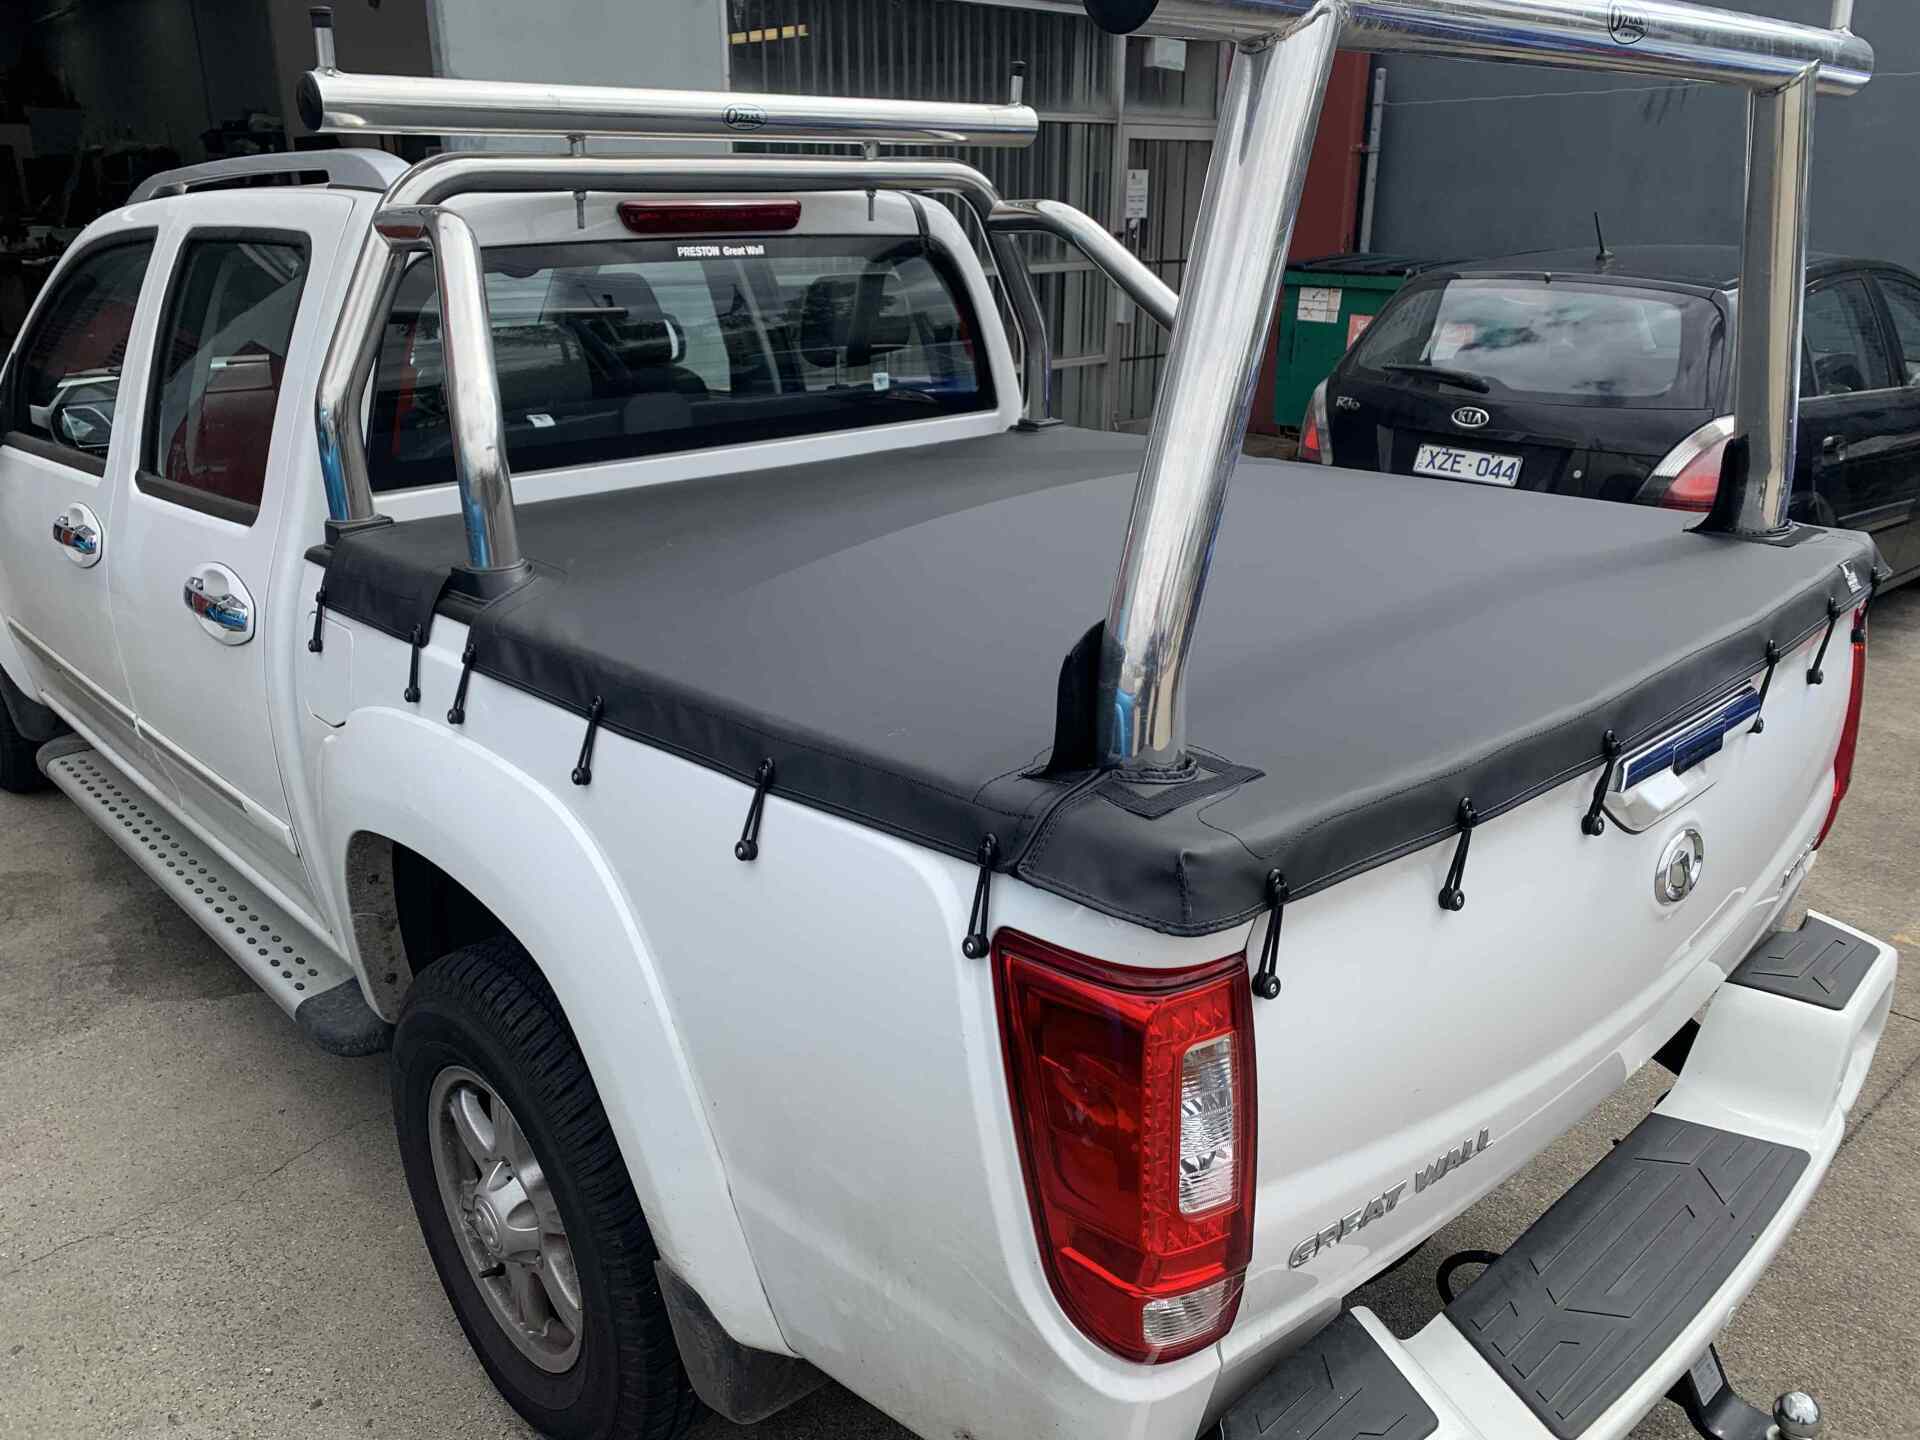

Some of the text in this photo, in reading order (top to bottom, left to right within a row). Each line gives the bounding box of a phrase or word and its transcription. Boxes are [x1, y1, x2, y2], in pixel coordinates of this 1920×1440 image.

[677, 245, 765, 257] PRESTON Great Wall
[1456, 409, 1483, 425] KIA
[1288, 1126, 1495, 1269] GREAT WALL
